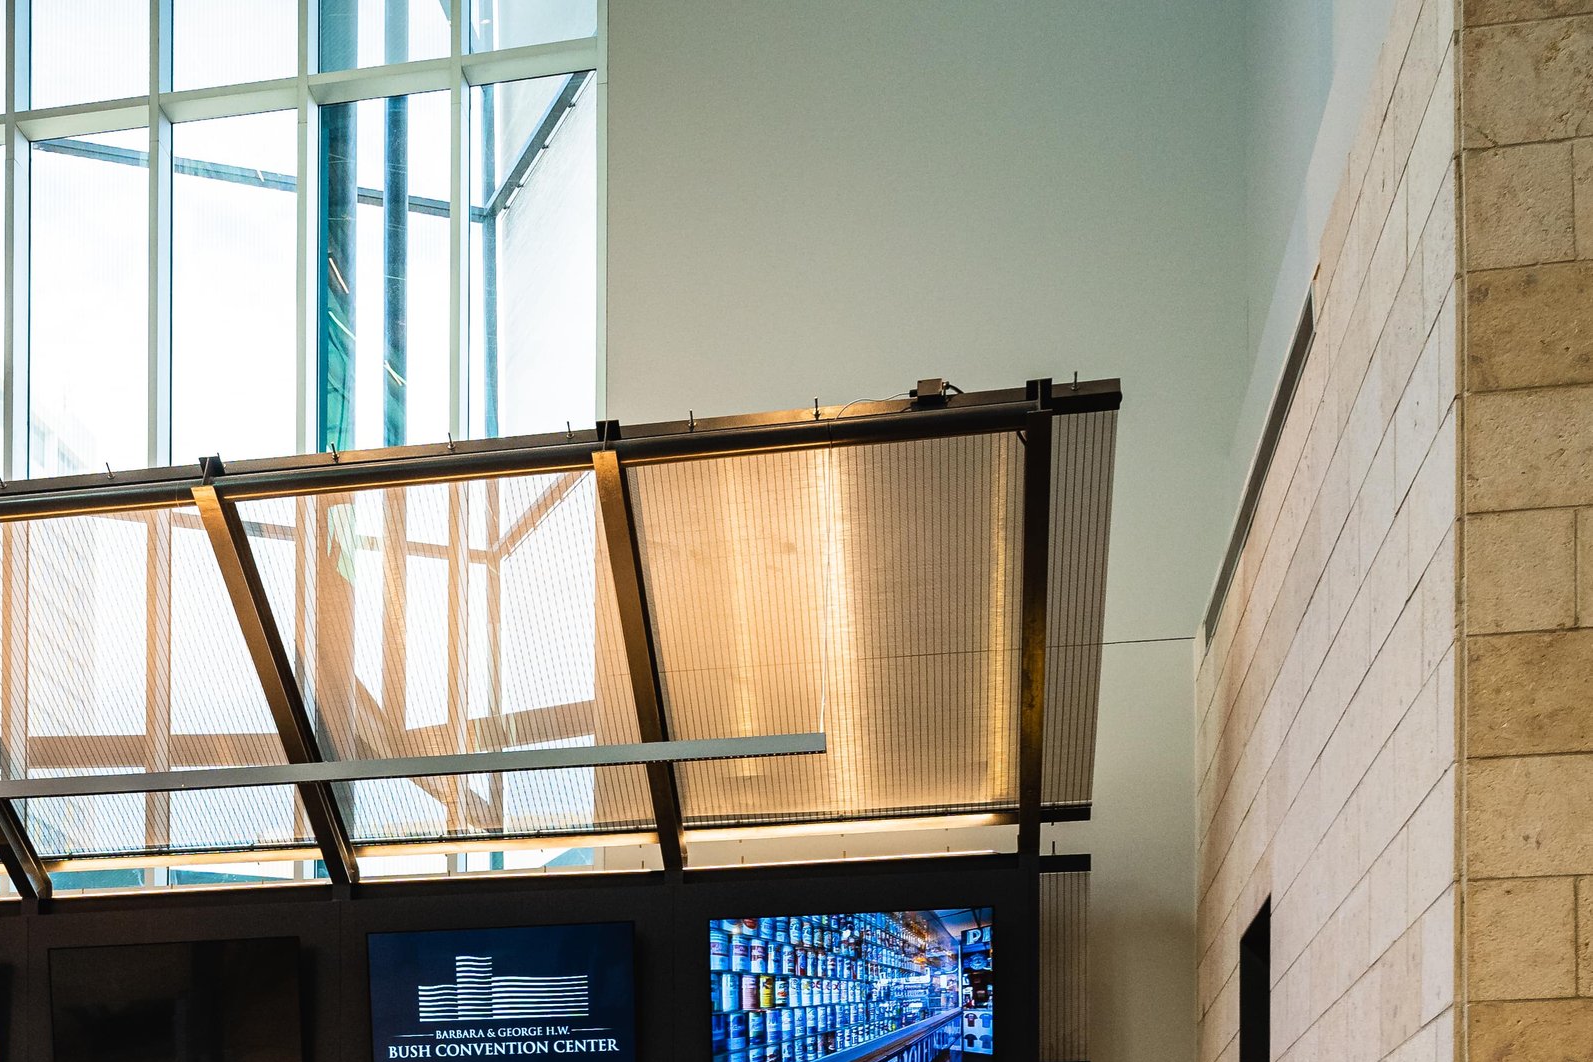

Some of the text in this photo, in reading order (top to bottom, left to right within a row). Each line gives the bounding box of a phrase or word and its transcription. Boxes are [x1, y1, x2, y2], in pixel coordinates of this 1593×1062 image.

[435, 1026, 570, 1039] BARBARA & GEORGE H.W.
[388, 1038, 620, 1059] BUSH CONVENTION CENTER
